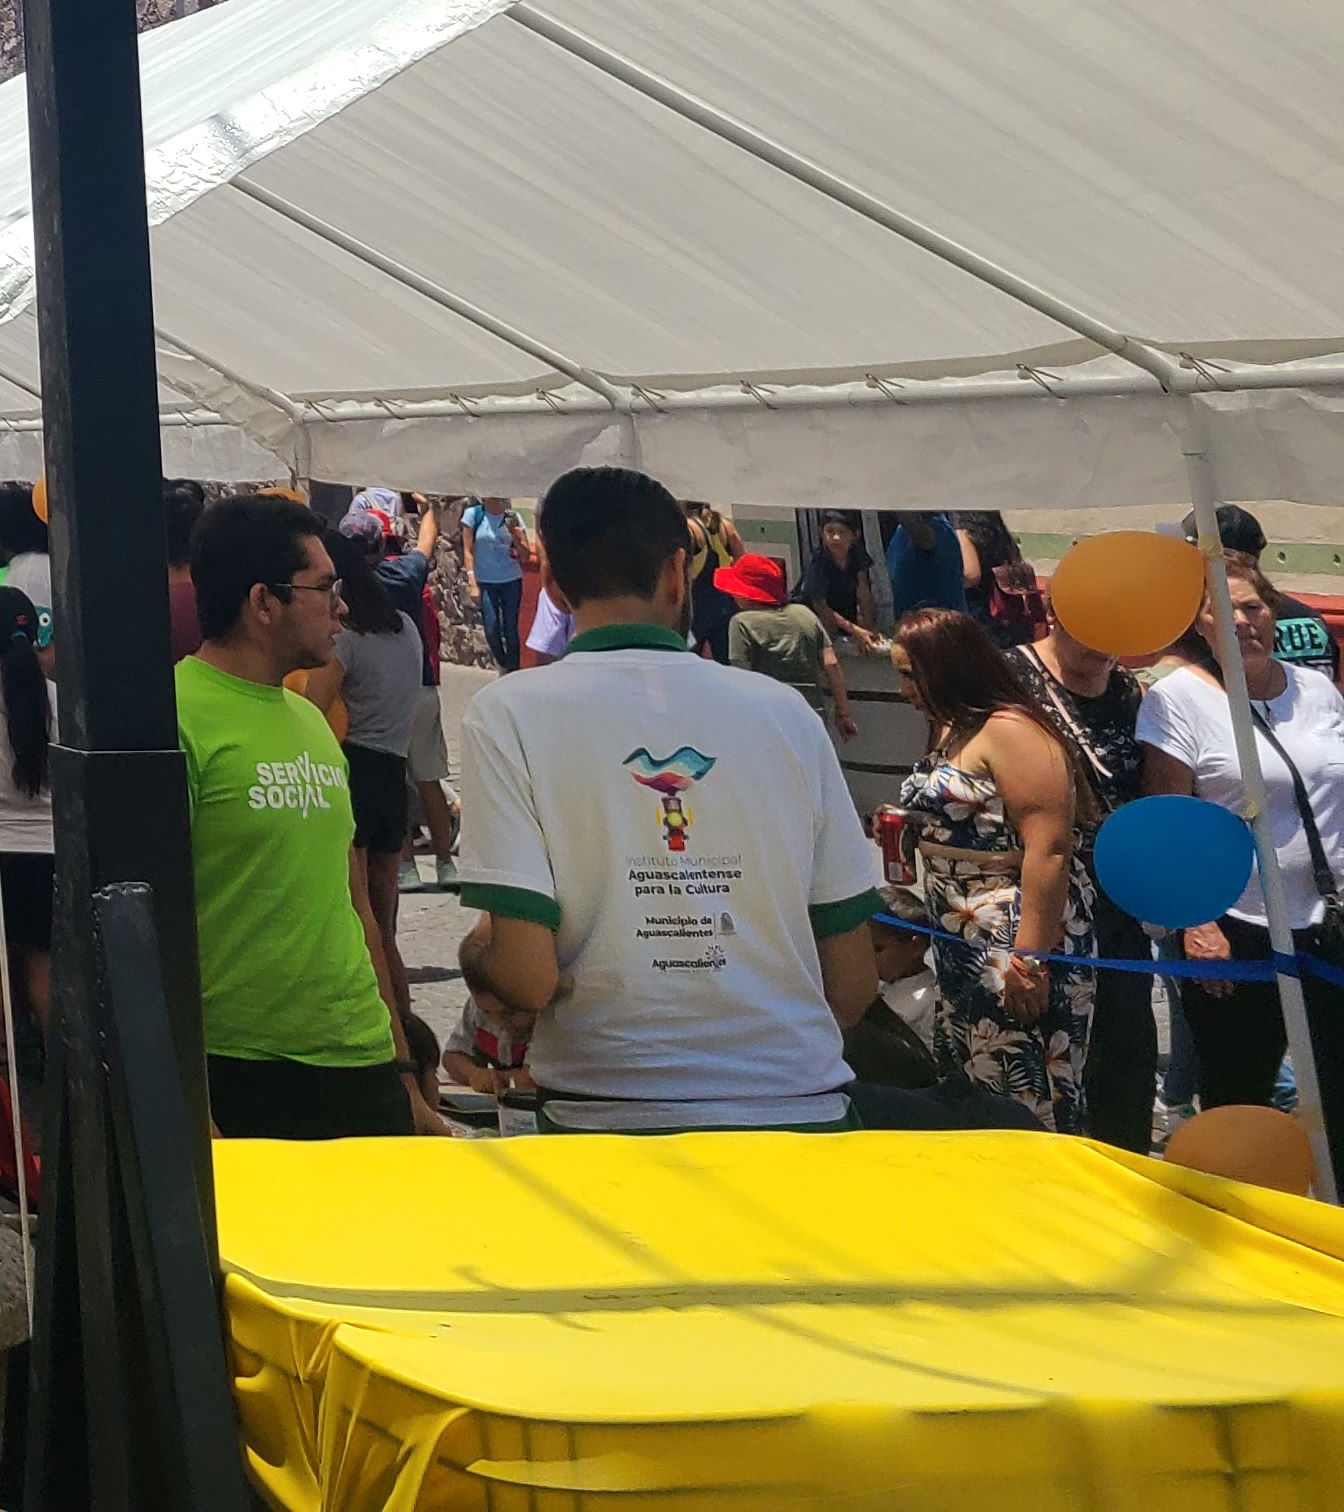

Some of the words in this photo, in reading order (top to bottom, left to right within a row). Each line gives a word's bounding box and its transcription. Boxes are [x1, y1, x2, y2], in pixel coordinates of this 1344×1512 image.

[247, 784, 331, 820] SOCIAL
[625, 855, 678, 867] Instituto
[635, 884, 665, 897] para
[668, 883, 682, 895] la
[685, 883, 730, 895] Cultura
[645, 915, 698, 927] Municipio
